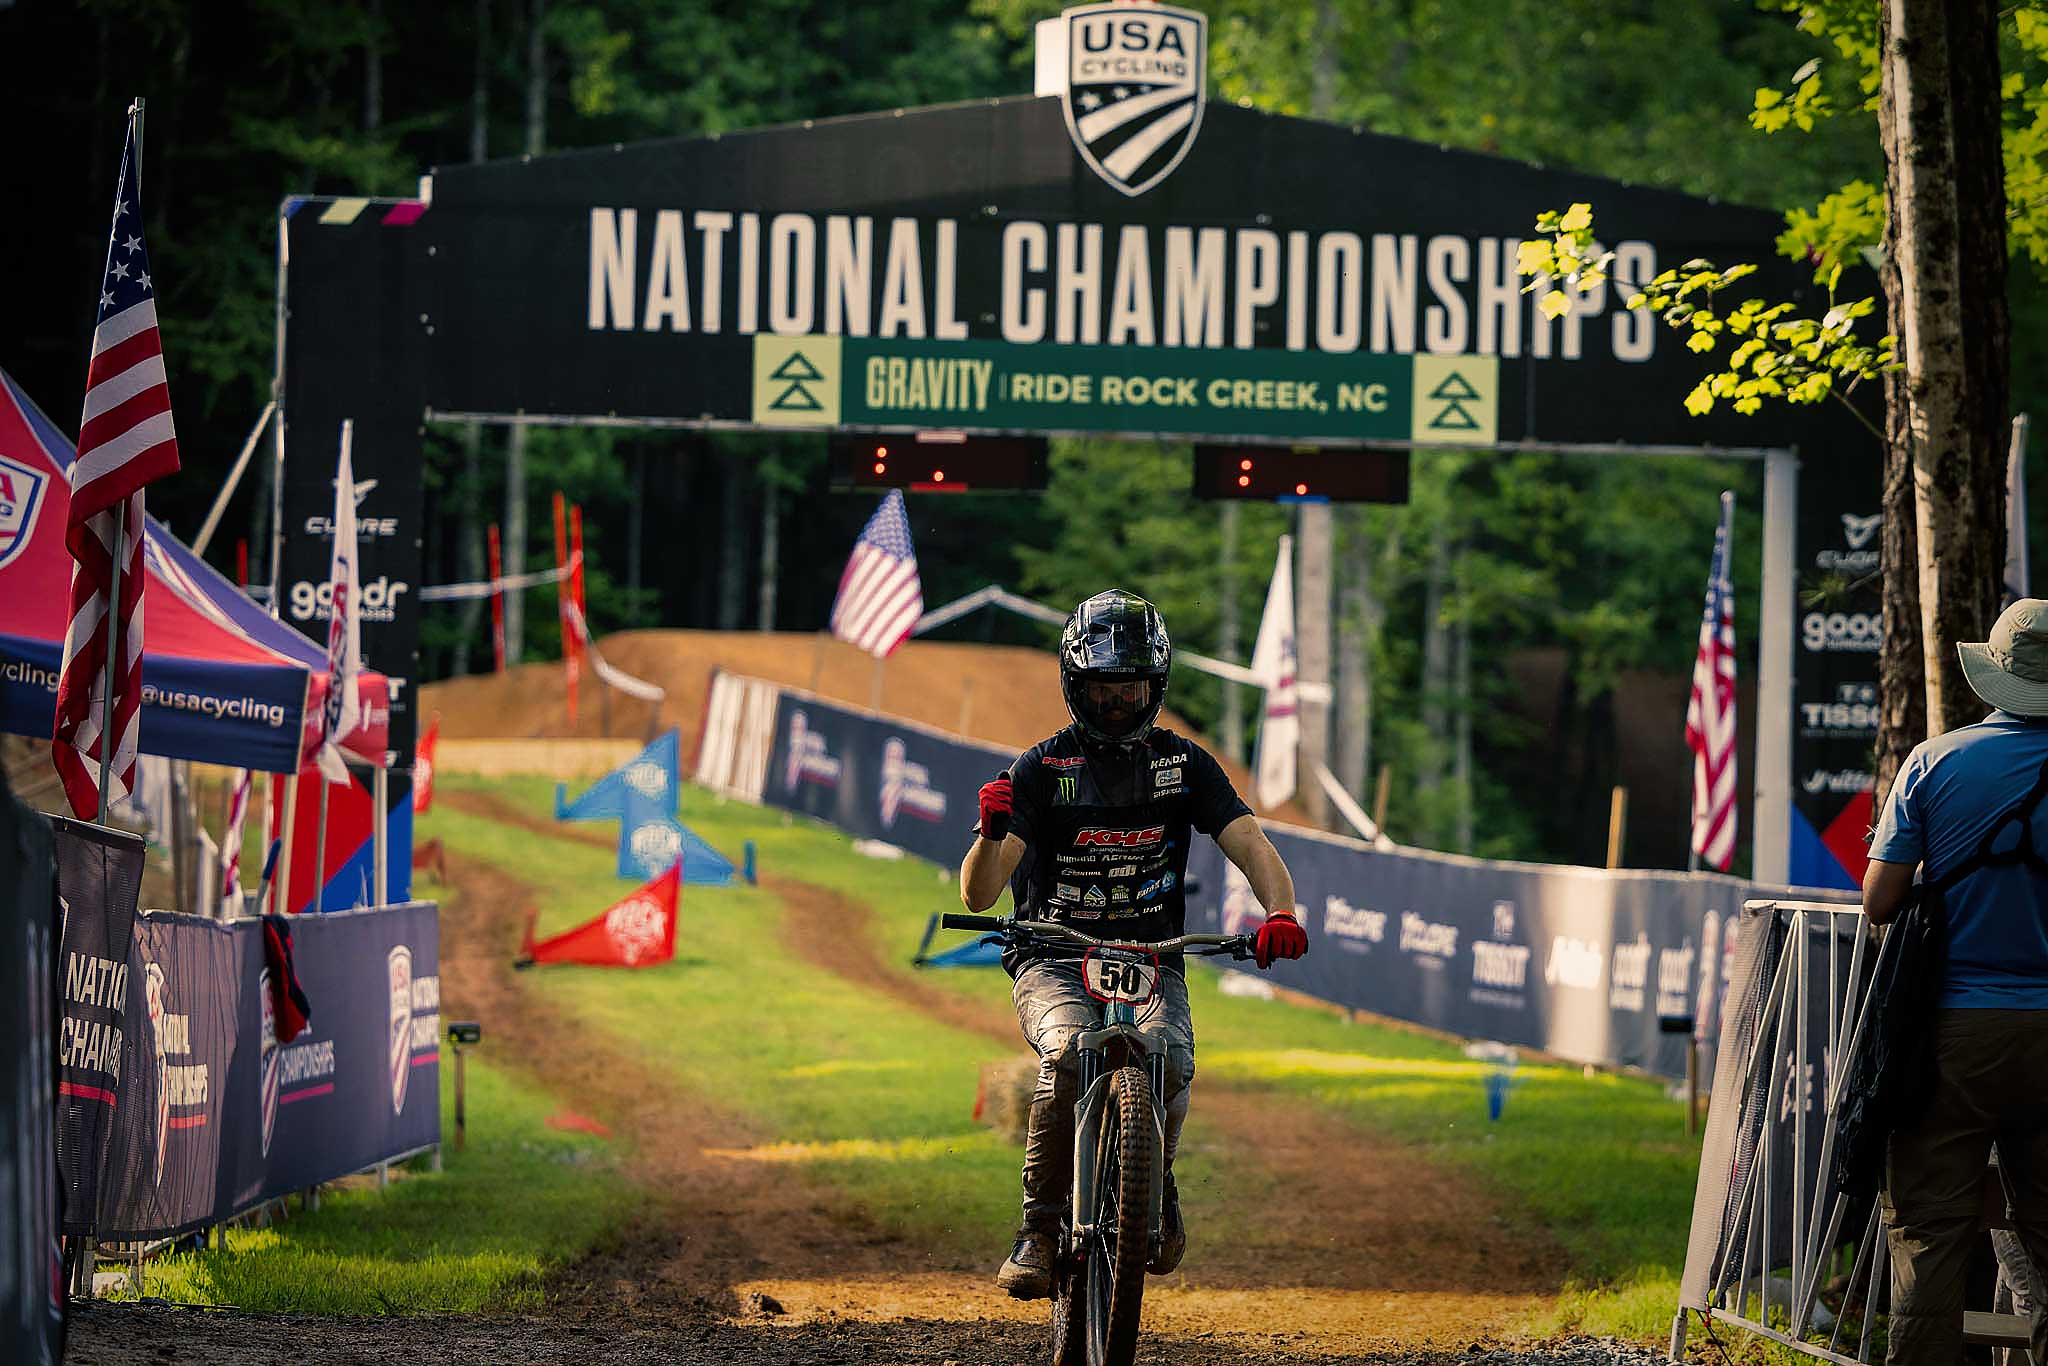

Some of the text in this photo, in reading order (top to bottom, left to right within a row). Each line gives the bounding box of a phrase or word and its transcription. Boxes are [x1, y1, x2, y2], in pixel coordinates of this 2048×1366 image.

[1083, 20, 1185, 57] USA
[1080, 57, 1188, 78] CYCLING
[587, 206, 1659, 362] NATIONAL CHAMPIONSHIPS
[866, 355, 1389, 414] GRAVITY RIDE ROCK CREEK, NC
[291, 576, 409, 621] godr
[141, 684, 285, 728] @usacycling
[1150, 753, 1188, 770] KENDA
[1073, 825, 1165, 847] KHS
[1100, 962, 1141, 995] 50
